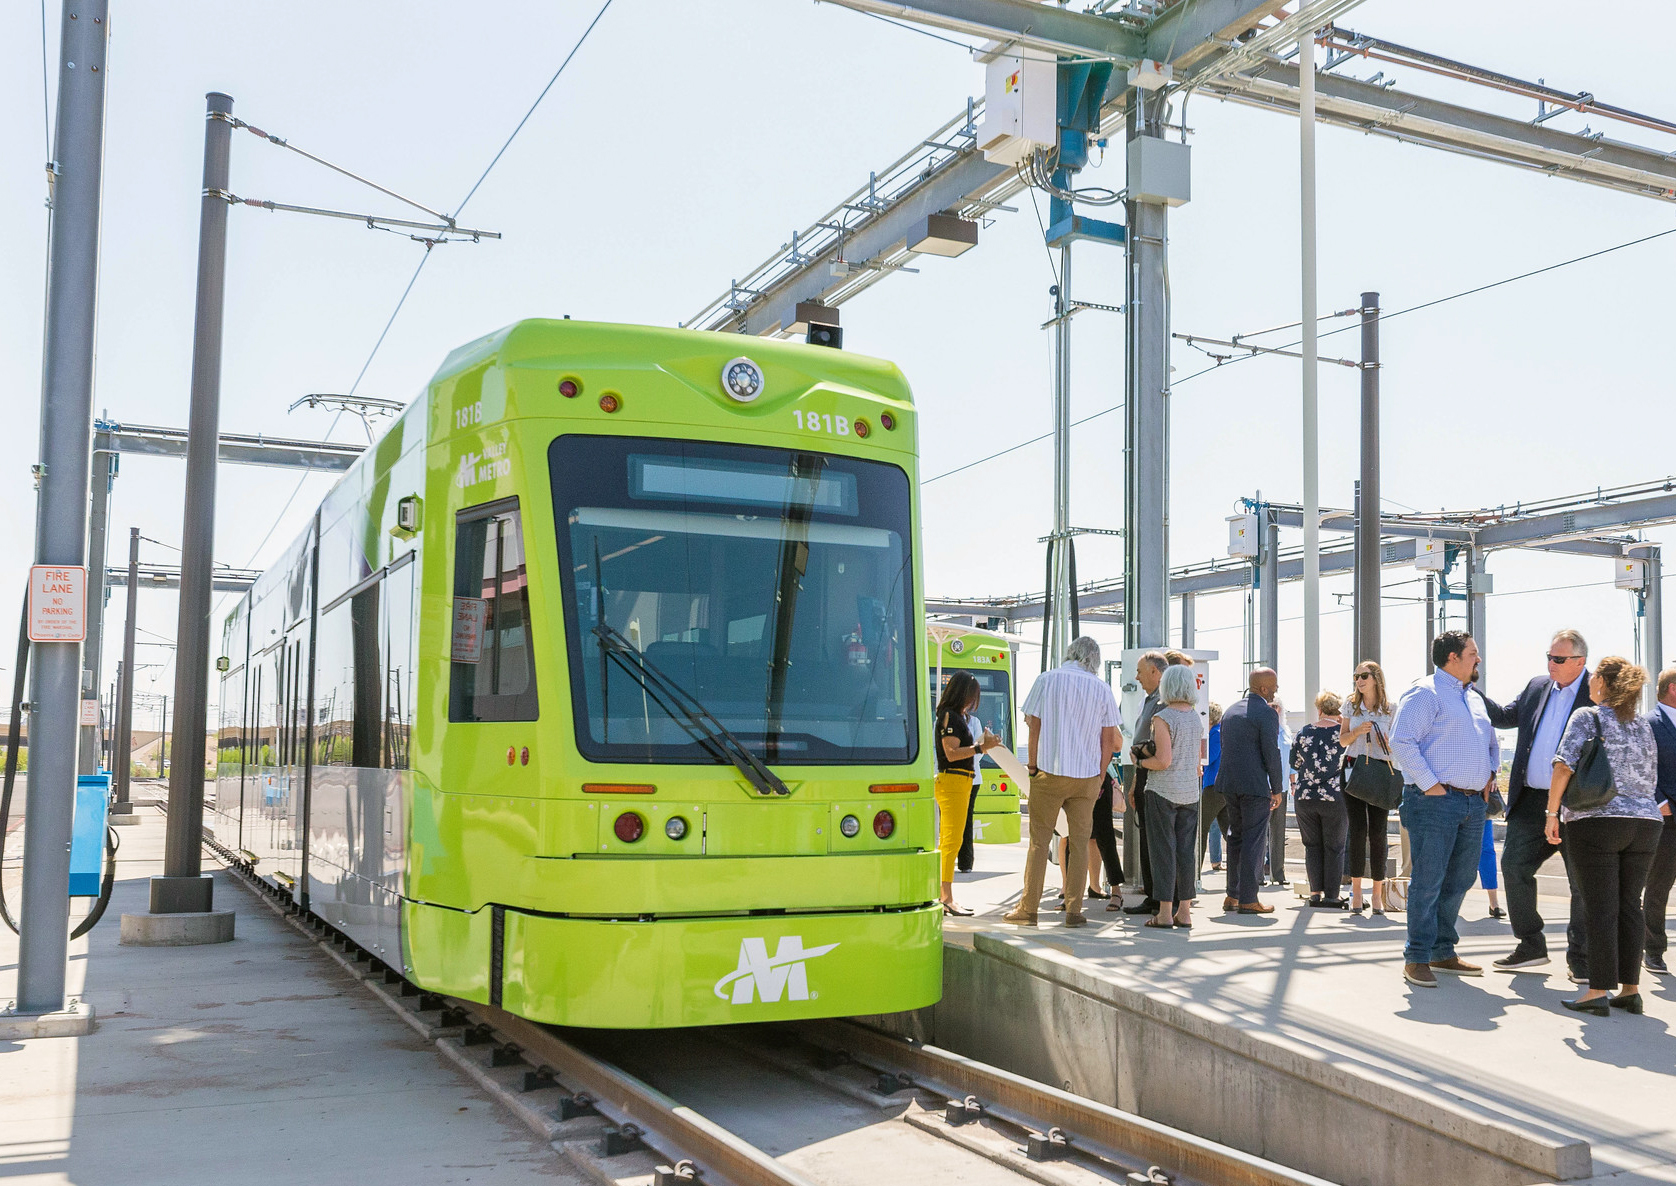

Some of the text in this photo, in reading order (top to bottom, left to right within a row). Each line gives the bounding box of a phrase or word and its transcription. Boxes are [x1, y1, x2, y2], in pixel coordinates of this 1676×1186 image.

[456, 401, 482, 429] 181B
[793, 409, 850, 436] 181B
[482, 442, 507, 460] VALLEY
[478, 458, 511, 483] METRO
[45, 571, 71, 582] FIRE
[42, 584, 73, 594] LANE
[52, 597, 63, 606] NO
[42, 607, 73, 615] PARKING
[973, 655, 991, 664] 183A
